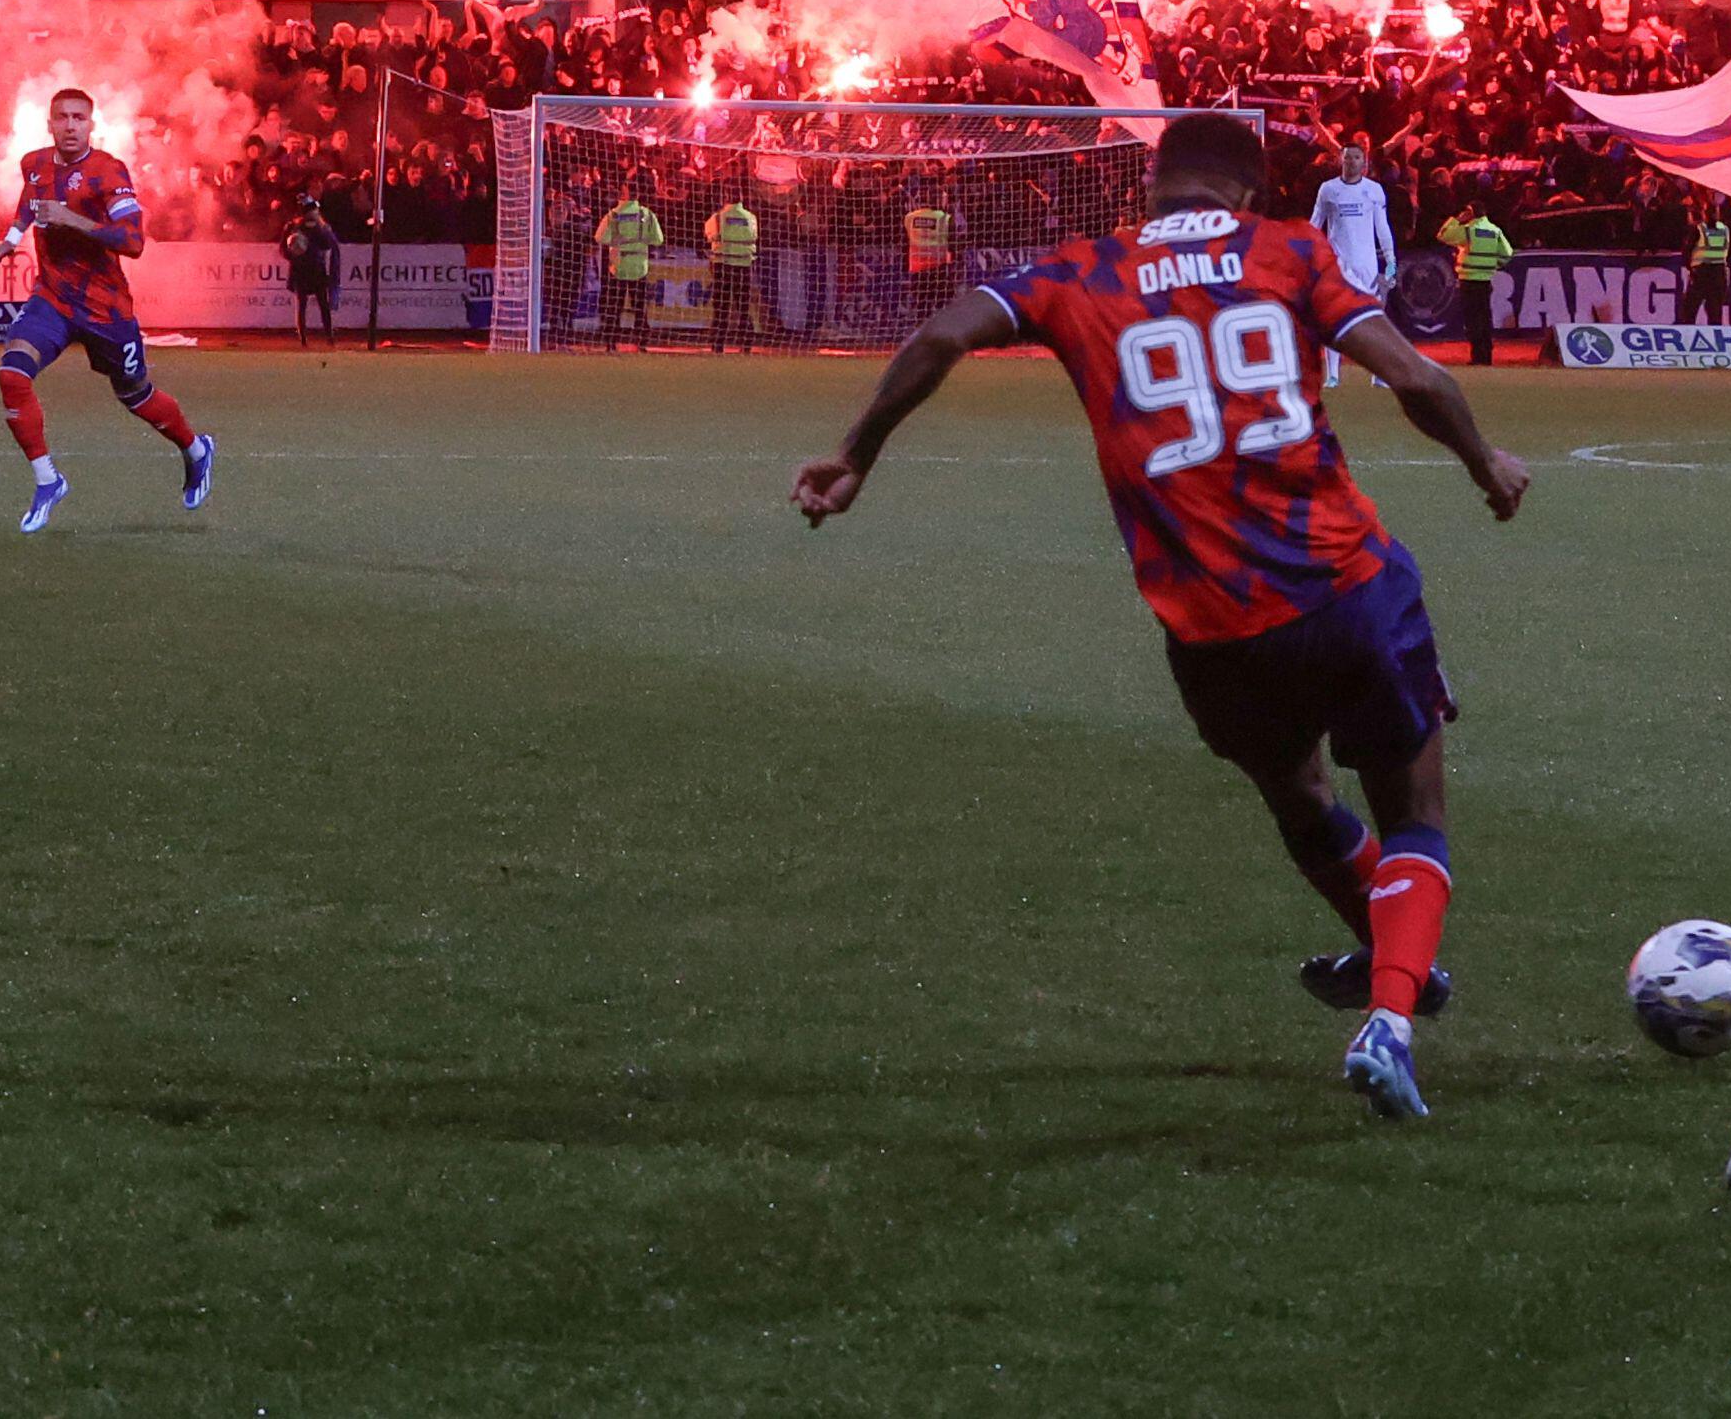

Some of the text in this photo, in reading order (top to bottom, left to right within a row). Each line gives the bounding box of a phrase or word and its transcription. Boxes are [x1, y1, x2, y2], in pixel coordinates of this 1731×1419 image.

[1137, 209, 1240, 244] SEKO
[1137, 252, 1243, 295] DANILO
[123, 341, 138, 363] 2
[1629, 353, 1693, 367] PEST
[1117, 300, 1314, 478] 99
